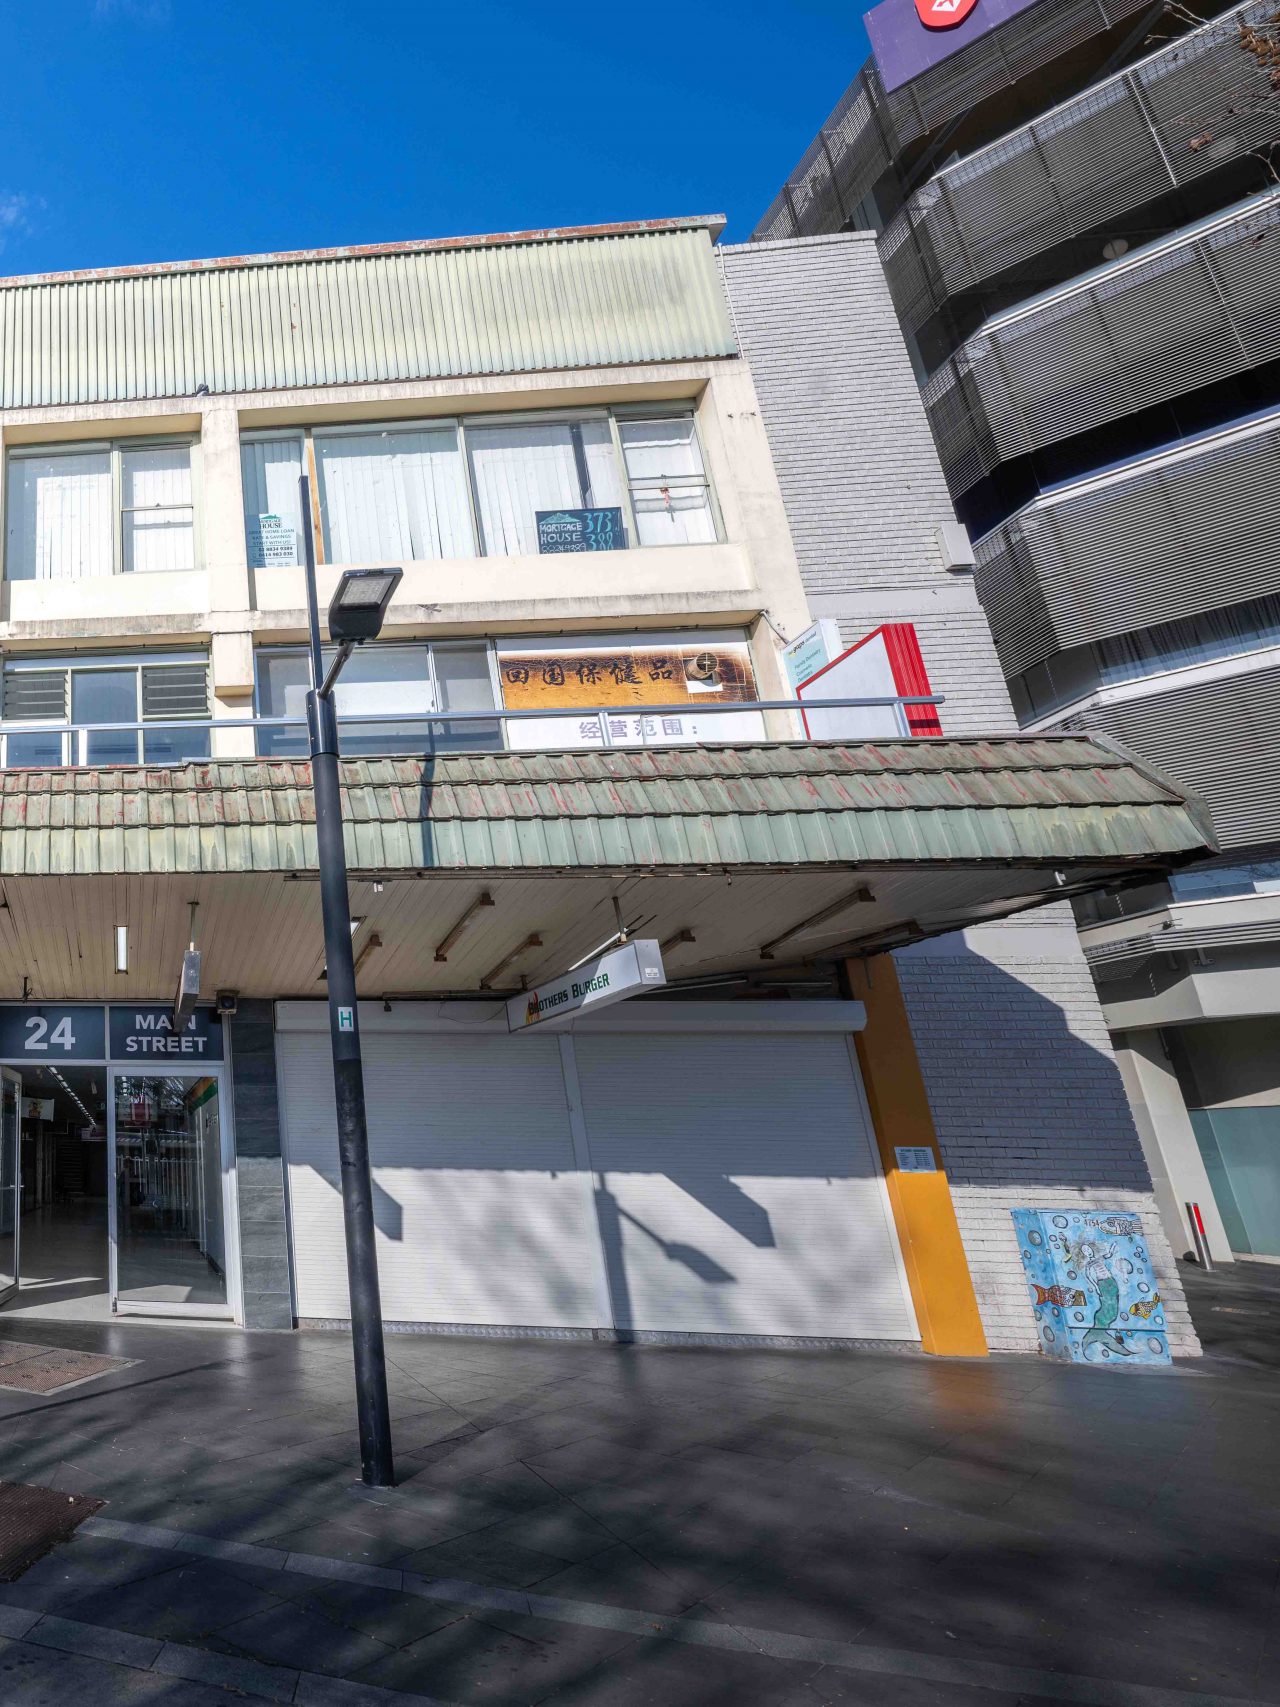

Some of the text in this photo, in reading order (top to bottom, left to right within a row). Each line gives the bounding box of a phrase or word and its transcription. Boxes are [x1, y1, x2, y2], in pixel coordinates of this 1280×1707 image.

[539, 522, 582, 533] MORTGAGE
[540, 532, 582, 544] HOUSE
[529, 972, 610, 1015] BROTHERS BURGER
[135, 1014, 196, 1030] MAN
[340, 1011, 352, 1028] H
[25, 1016, 76, 1050] 24
[125, 1036, 208, 1052] STREET
